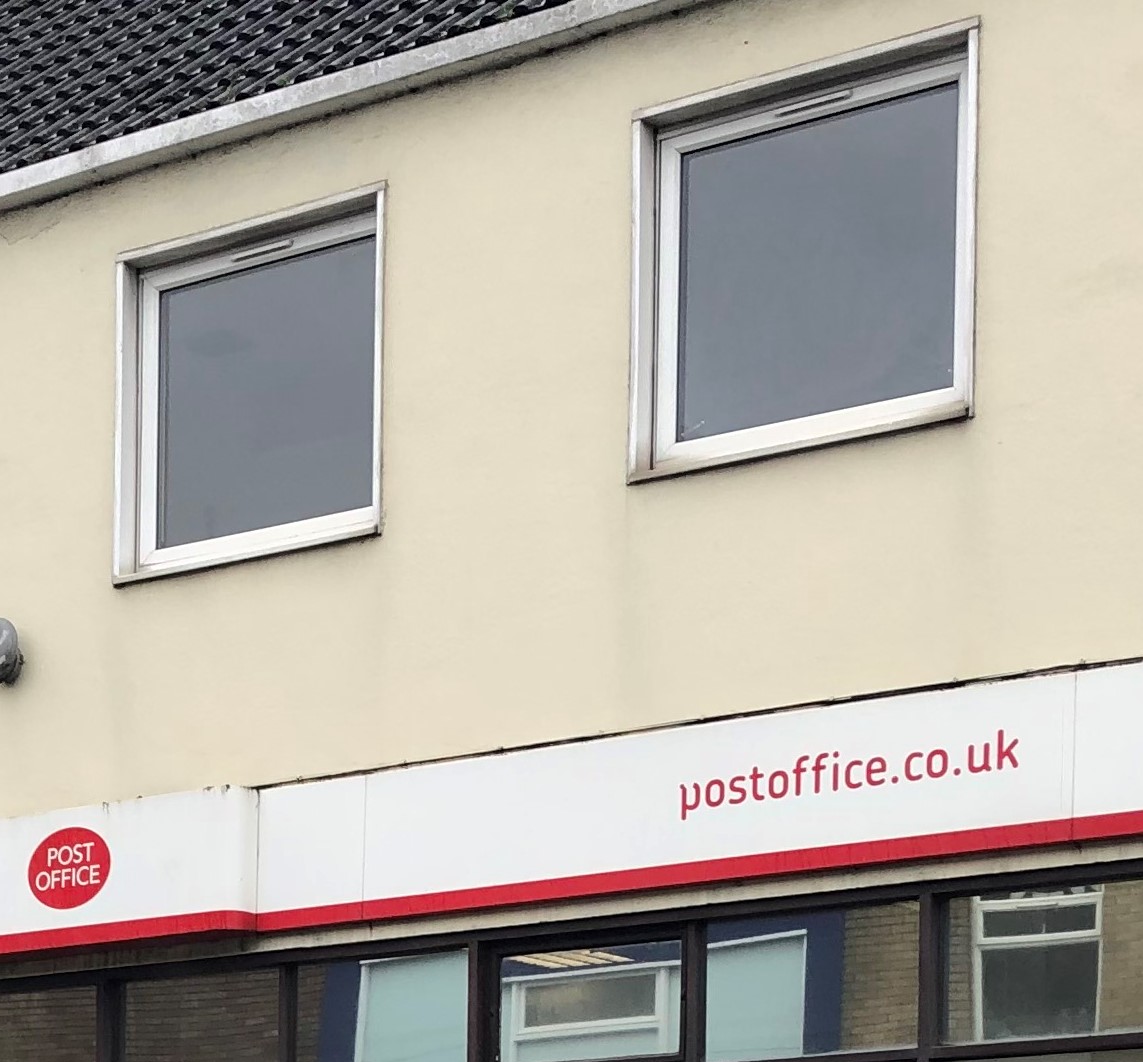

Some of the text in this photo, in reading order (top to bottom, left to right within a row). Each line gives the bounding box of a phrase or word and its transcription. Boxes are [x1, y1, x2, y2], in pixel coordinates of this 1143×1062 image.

[679, 729, 1020, 821] postoffice.co.uk
[46, 841, 92, 868] POST
[35, 863, 102, 891] OFFICE
